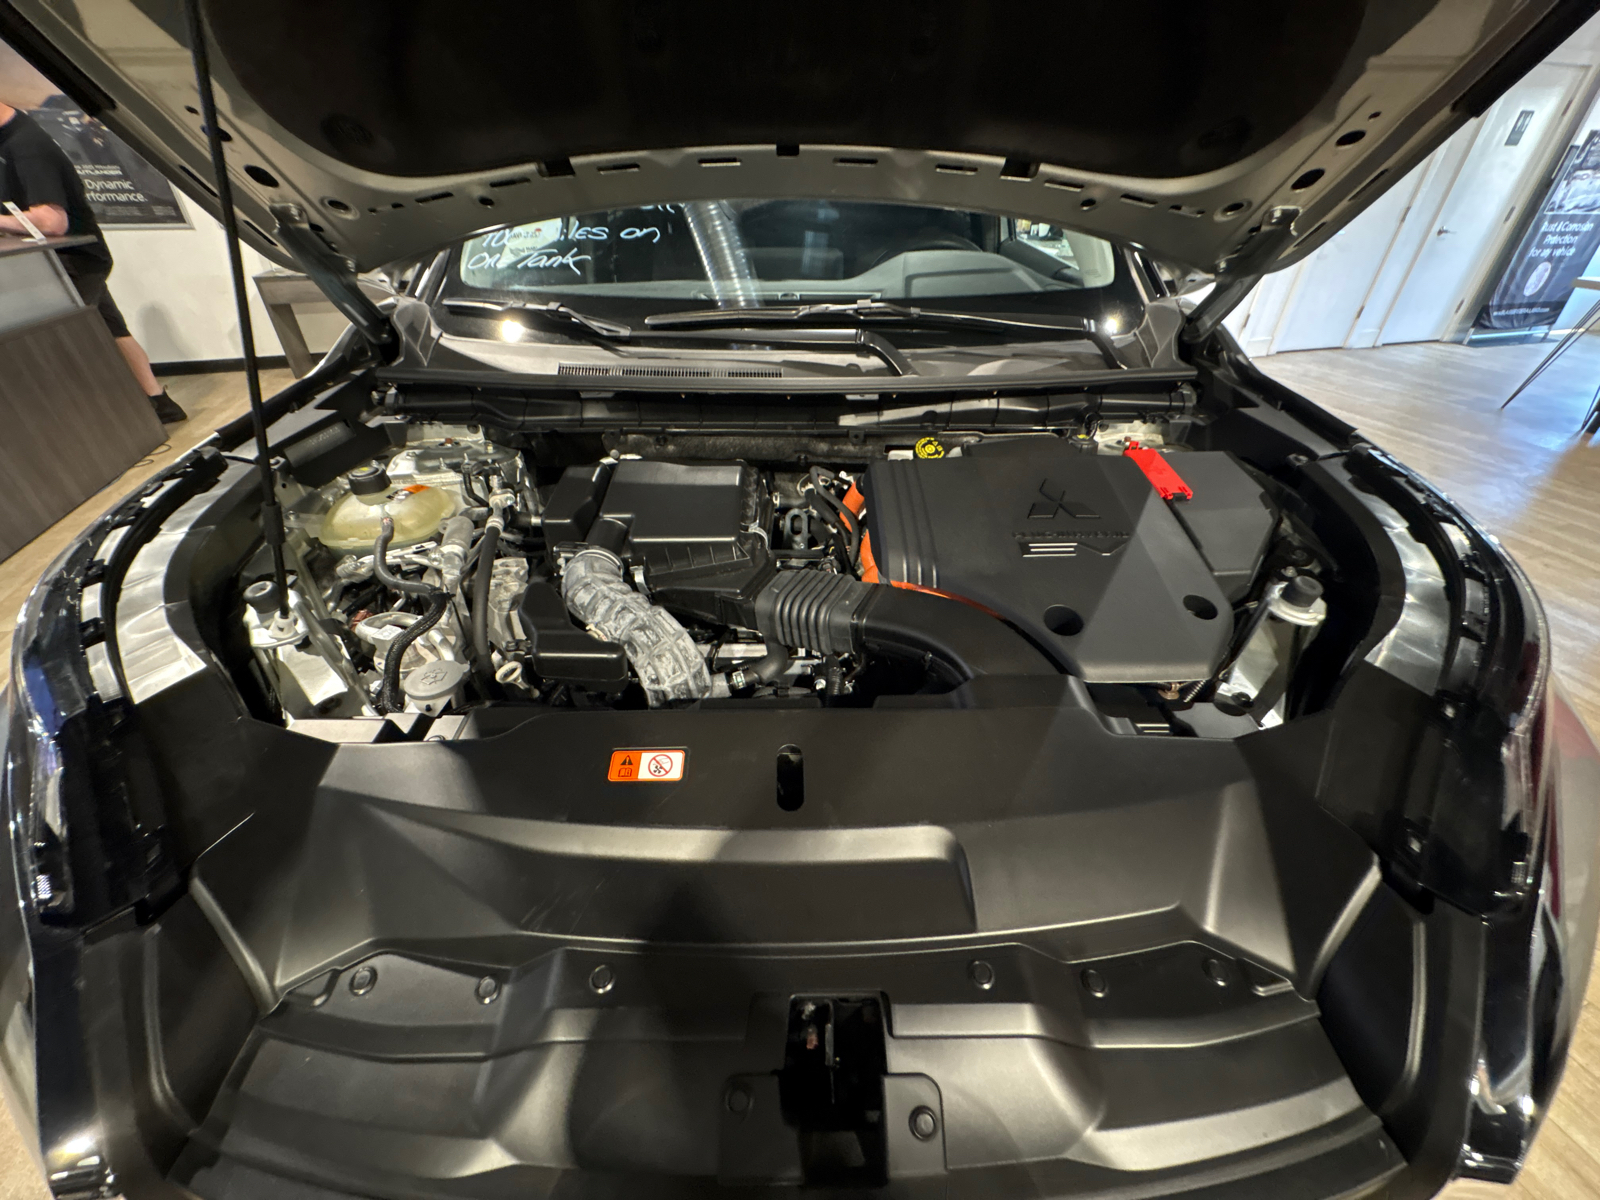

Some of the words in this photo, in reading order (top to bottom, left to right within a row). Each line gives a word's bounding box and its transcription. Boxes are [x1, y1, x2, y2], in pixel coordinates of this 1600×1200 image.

[84, 179, 135, 191] Dynamic
[86, 191, 147, 202] rformance.
[620, 226, 661, 243] on
[517, 247, 591, 276] Tank
